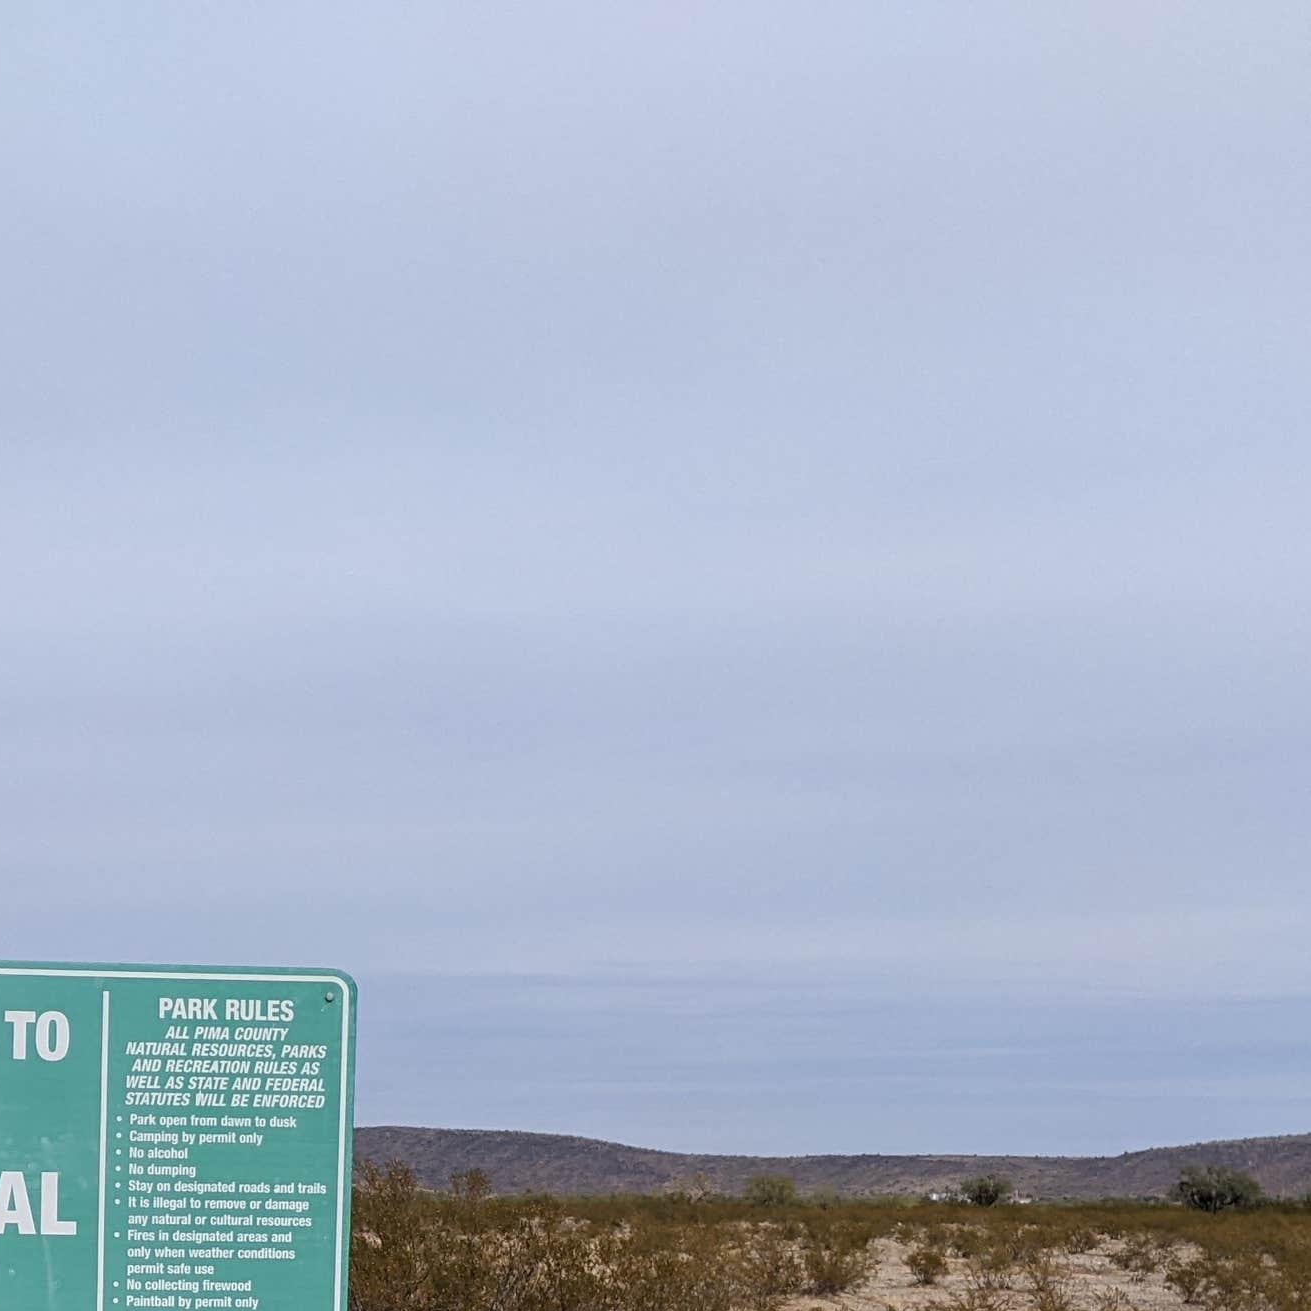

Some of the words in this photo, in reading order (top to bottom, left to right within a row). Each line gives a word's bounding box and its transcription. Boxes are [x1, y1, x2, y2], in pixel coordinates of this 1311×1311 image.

[159, 997, 217, 1020] PARK
[225, 998, 294, 1022] RULES
[4, 1010, 70, 1061] TO
[164, 1025, 189, 1039] ALL
[194, 1026, 229, 1040] PIMA
[234, 1026, 289, 1041] COUNTY
[125, 1041, 187, 1056] NATURAL
[191, 1042, 276, 1060] RESOURCES,
[280, 1044, 327, 1059] PARKS
[131, 1058, 162, 1072] AND
[165, 1059, 250, 1074] RECREATION
[253, 1060, 297, 1075] RULES
[300, 1061, 320, 1075] AS
[126, 1074, 161, 1089] WELL
[164, 1075, 184, 1089] AS
[187, 1076, 229, 1090] STATE
[231, 1077, 261, 1091] AND
[264, 1077, 325, 1092] FEDERAL
[124, 1091, 191, 1106] STATUTES
[195, 1091, 226, 1107] WILL
[230, 1093, 250, 1107] BE
[252, 1093, 325, 1108] ENFORCED
[129, 1113, 156, 1125] Park
[159, 1116, 187, 1128] open
[190, 1114, 217, 1126] from
[220, 1115, 251, 1127] dawn
[254, 1116, 266, 1127] to
[269, 1116, 297, 1128] dusk
[129, 1129, 178, 1145] Camping
[181, 1131, 196, 1145] by
[198, 1131, 236, 1145] permit
[239, 1132, 263, 1146] only
[128, 1146, 144, 1158] No
[147, 1146, 188, 1159] alcohol
[128, 1163, 144, 1175] No
[147, 1163, 196, 1178] dumping
[128, 1179, 153, 1193] Stay
[156, 1182, 171, 1191] on
[173, 1180, 235, 1194] designated
[238, 1182, 270, 1193] roads
[273, 1182, 294, 1193] and
[297, 1182, 326, 1194] trails
[128, 1196, 137, 1208] It
[139, 1196, 150, 1208] is
[153, 1196, 186, 1210] illegal
[189, 1197, 201, 1208] to
[204, 1199, 246, 1209] remove
[249, 1200, 262, 1210] or
[264, 1198, 309, 1213] damage
[127, 1215, 148, 1226] any
[151, 1213, 191, 1225] natural
[194, 1216, 207, 1225] or
[209, 1214, 253, 1226] cultural
[256, 1216, 312, 1227] resources
[127, 1229, 155, 1241] Fires
[158, 1229, 169, 1241] in
[172, 1229, 233, 1244] designated
[236, 1232, 268, 1242] areas
[271, 1231, 292, 1243] and
[127, 1245, 151, 1260] only
[154, 1246, 185, 1258] when
[188, 1246, 234, 1259] weather
[237, 1247, 295, 1259] conditions
[127, 1262, 164, 1274] permit
[166, 1262, 191, 1274] safe
[194, 1265, 214, 1275] use
[126, 1278, 142, 1290] No
[144, 1278, 199, 1293] collecting
[202, 1279, 251, 1291] firewood
[126, 1295, 175, 1307] Paintball
[177, 1295, 192, 1309] by
[195, 1296, 232, 1310] permit
[234, 1296, 259, 1310] only
